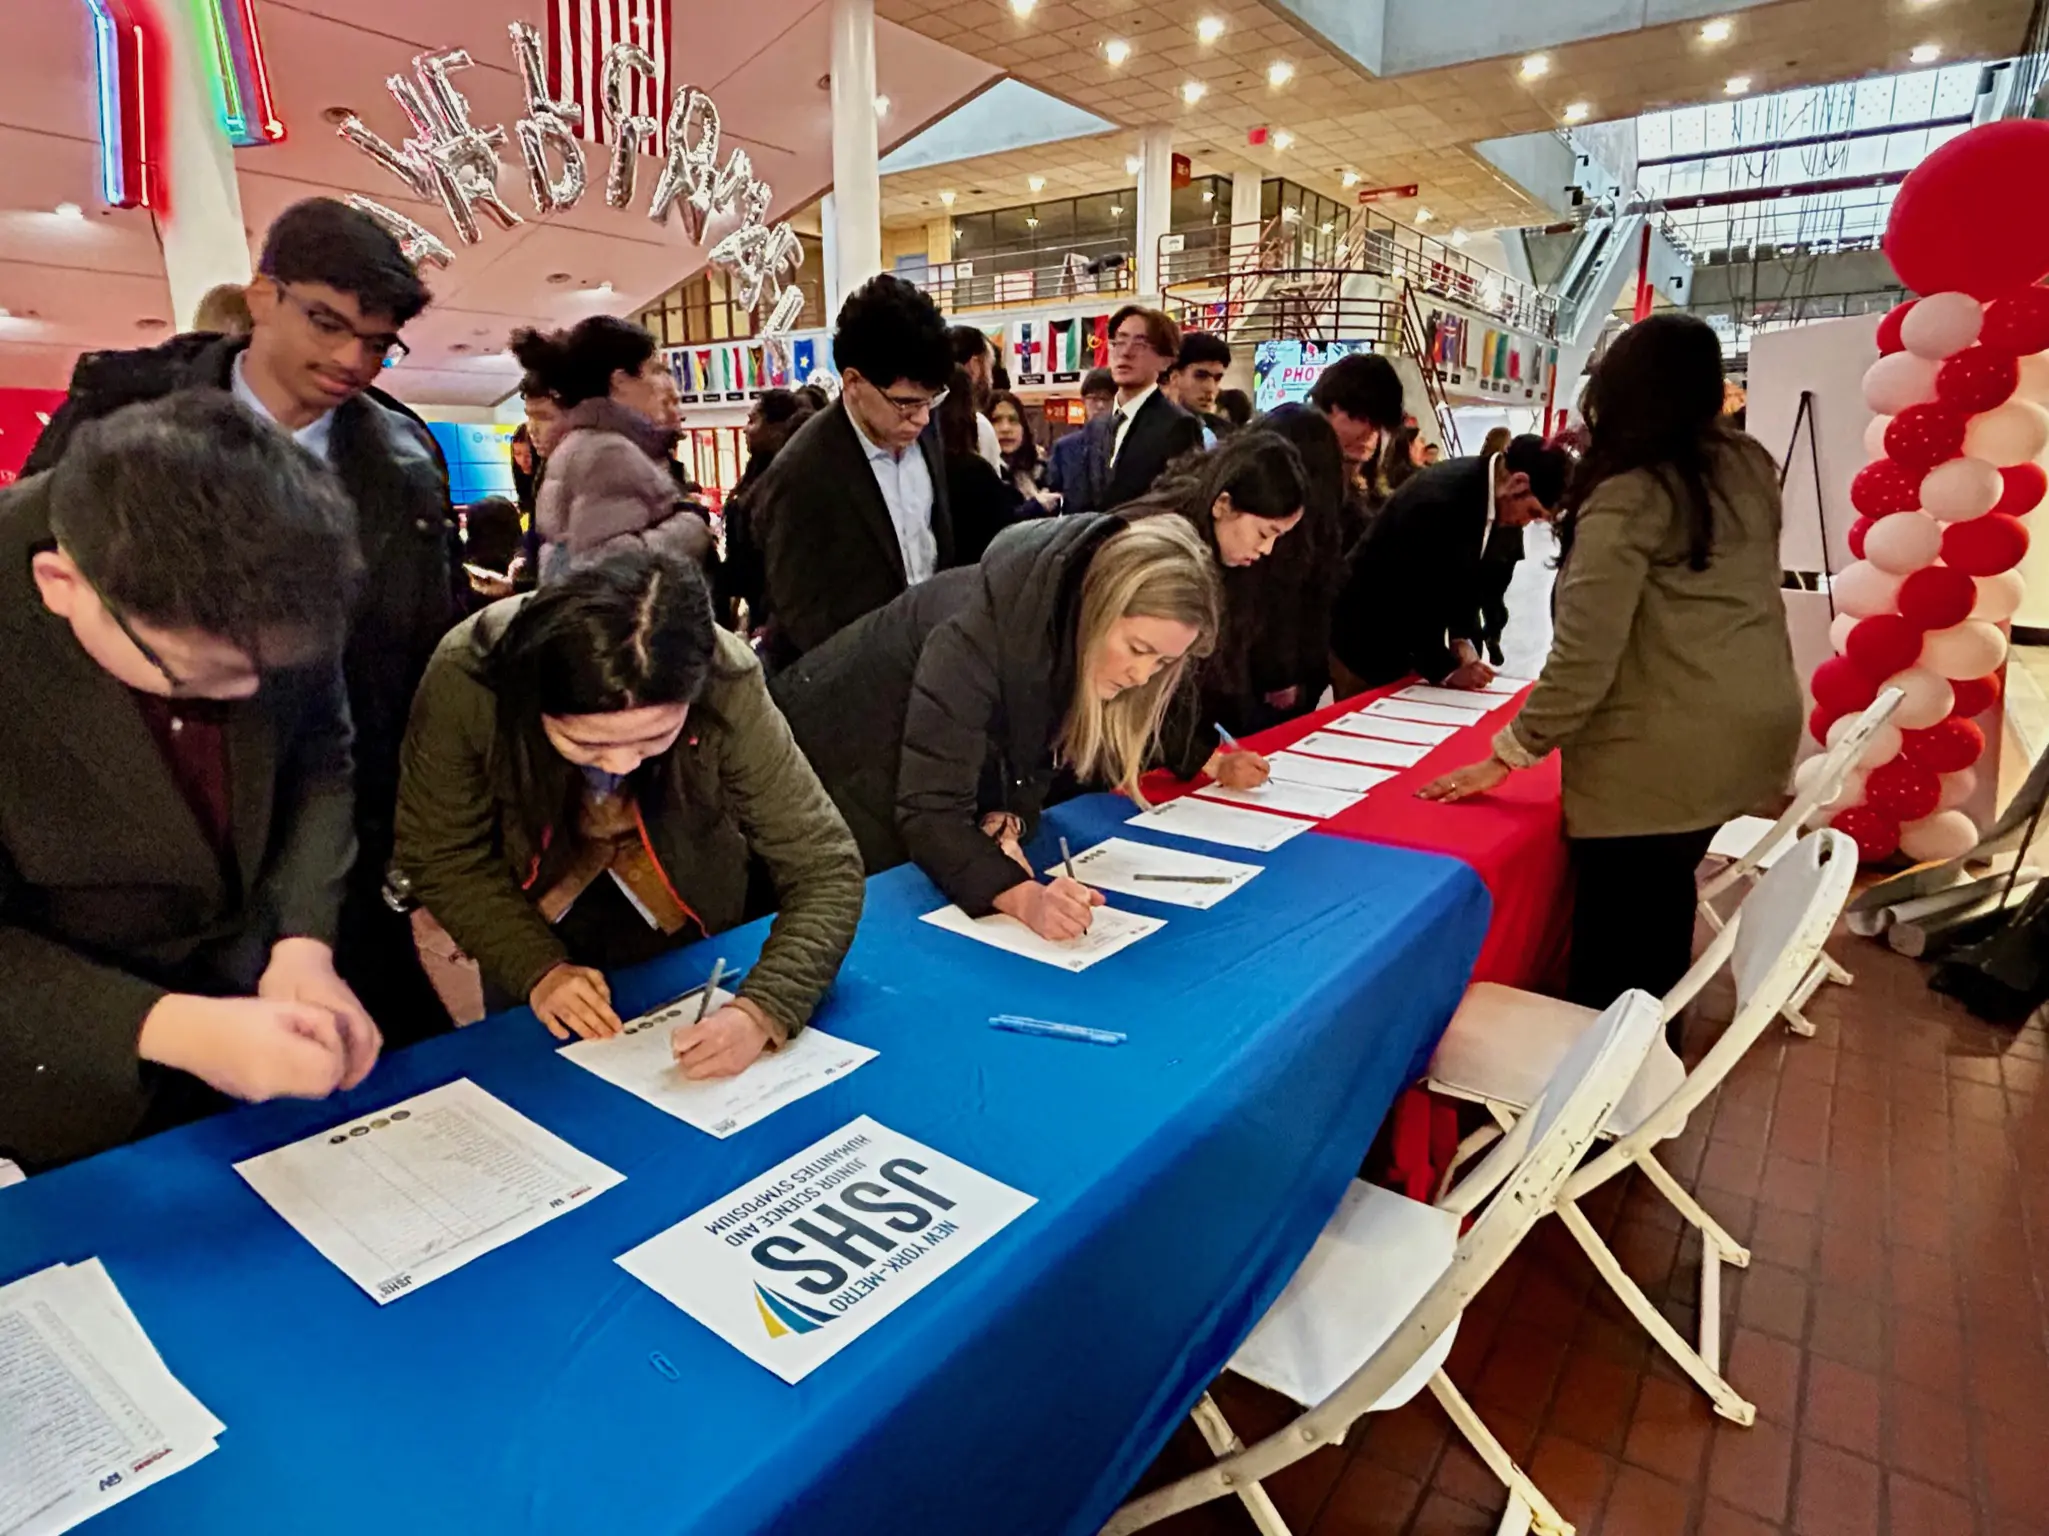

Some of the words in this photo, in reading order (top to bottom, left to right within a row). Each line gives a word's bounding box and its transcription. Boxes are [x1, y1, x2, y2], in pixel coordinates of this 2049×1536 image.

[1283, 367, 1324, 382] PHO
[791, 1133, 872, 1182] HUMANITIES
[815, 1157, 867, 1192] JUNIOR
[703, 1177, 796, 1237] SYMPOSIUM
[760, 1186, 821, 1229] SCIENCE
[724, 1222, 761, 1248] AND
[751, 1158, 957, 1296] JSHS
[920, 1219, 959, 1247] NEW
